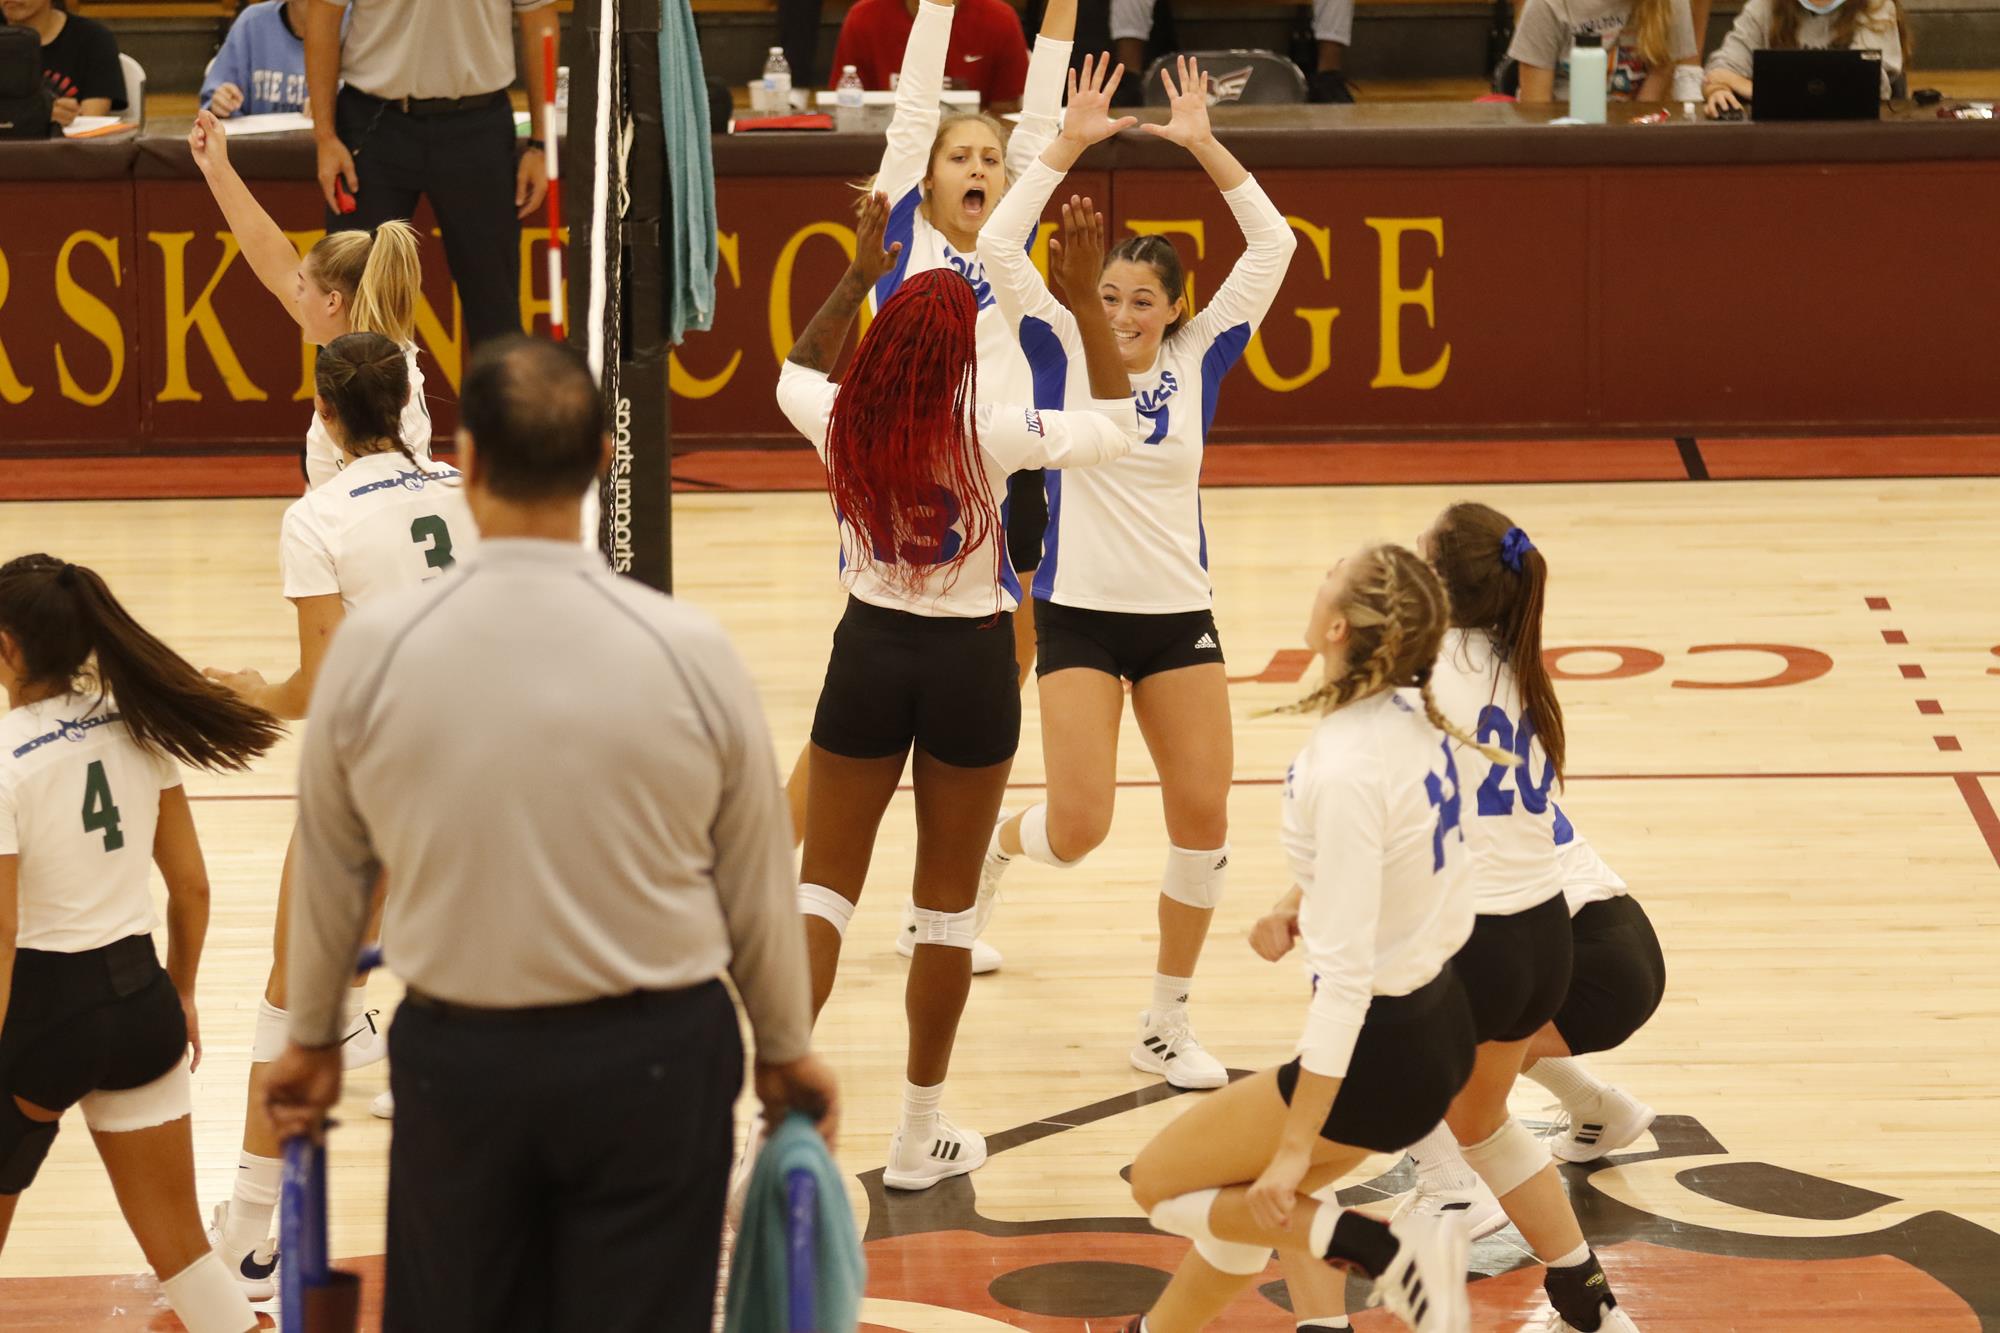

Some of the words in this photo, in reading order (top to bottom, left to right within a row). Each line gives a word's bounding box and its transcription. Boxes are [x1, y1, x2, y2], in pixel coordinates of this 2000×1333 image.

[0, 227, 570, 405] SKNE
[616, 398, 634, 474] sports
[1131, 371, 1178, 410] LVES
[410, 515, 457, 581] 3
[615, 479, 634, 572] imports
[1477, 704, 1556, 815] 20
[82, 760, 124, 852] 4
